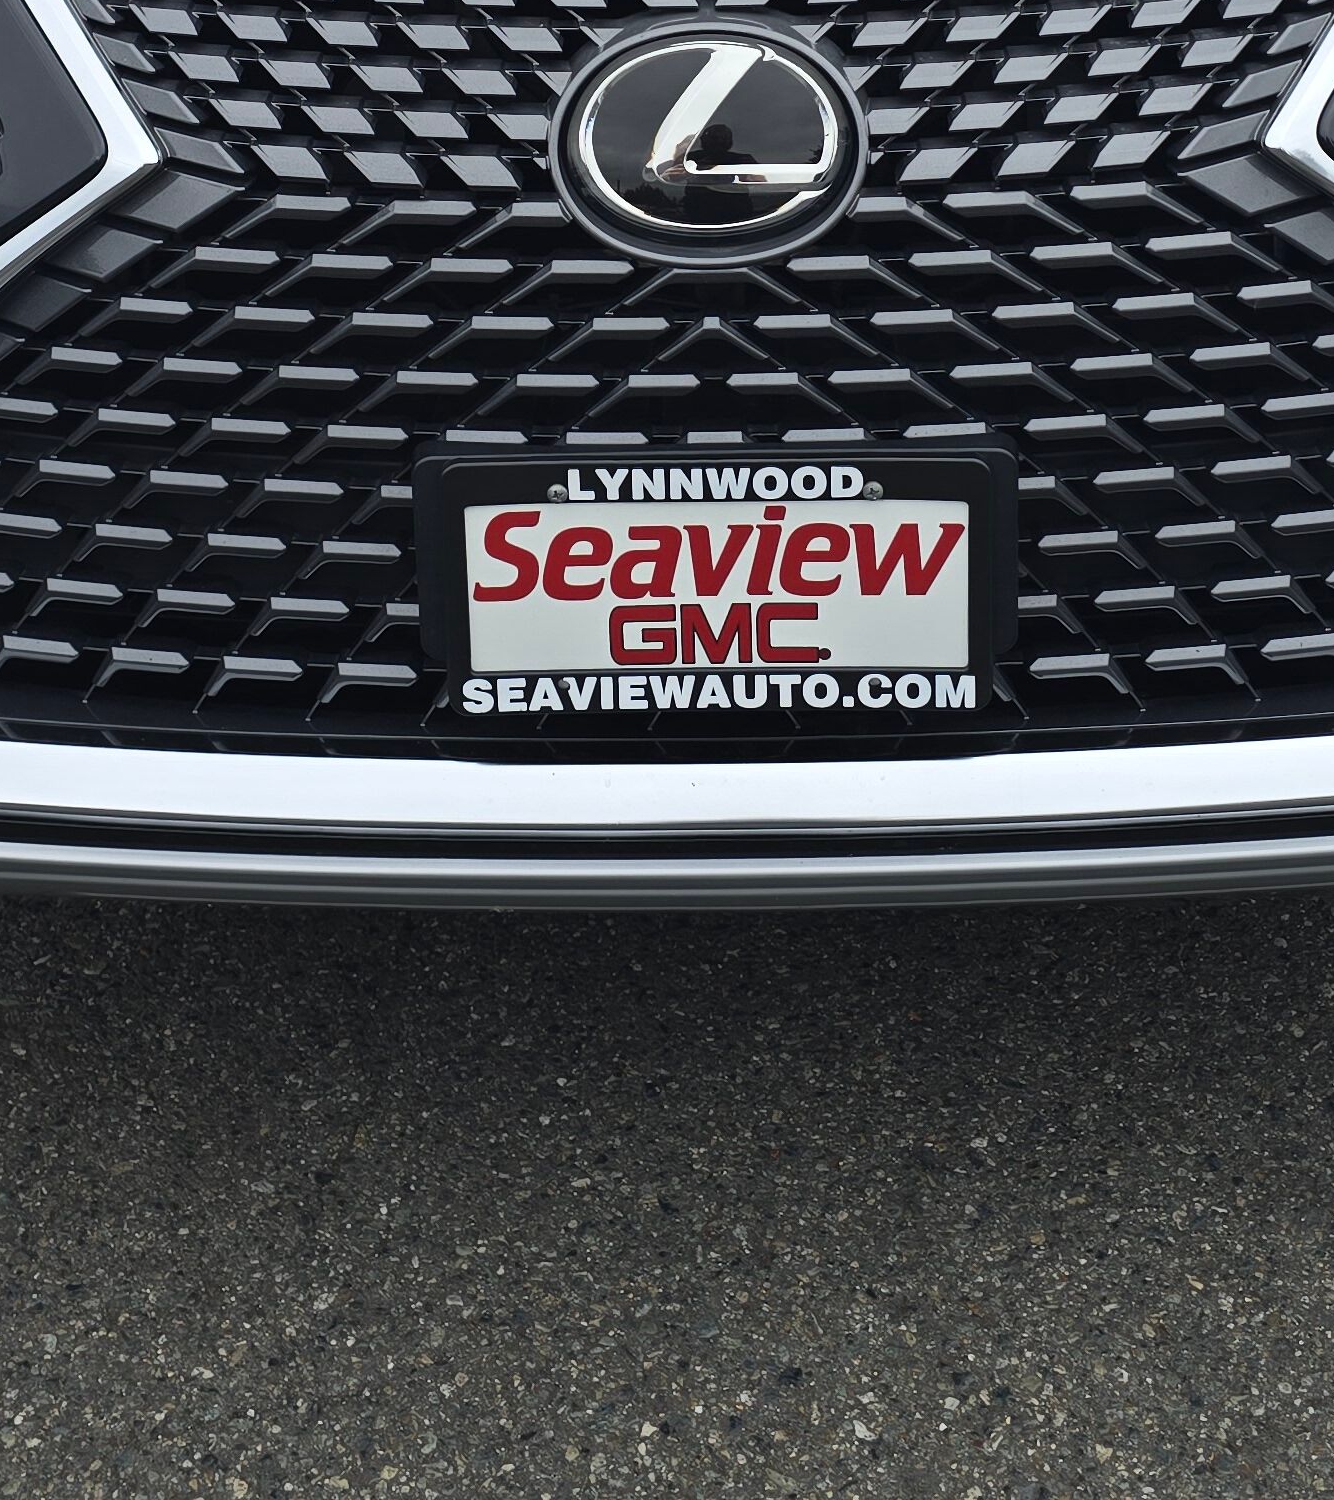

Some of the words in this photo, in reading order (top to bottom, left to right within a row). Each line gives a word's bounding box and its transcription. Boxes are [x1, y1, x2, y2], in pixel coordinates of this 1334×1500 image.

[568, 467, 864, 500] LYNNWOOD
[473, 506, 965, 602] Seaview
[609, 603, 832, 664] GMC
[462, 674, 976, 712] SEAVIEWAUTO.COM
